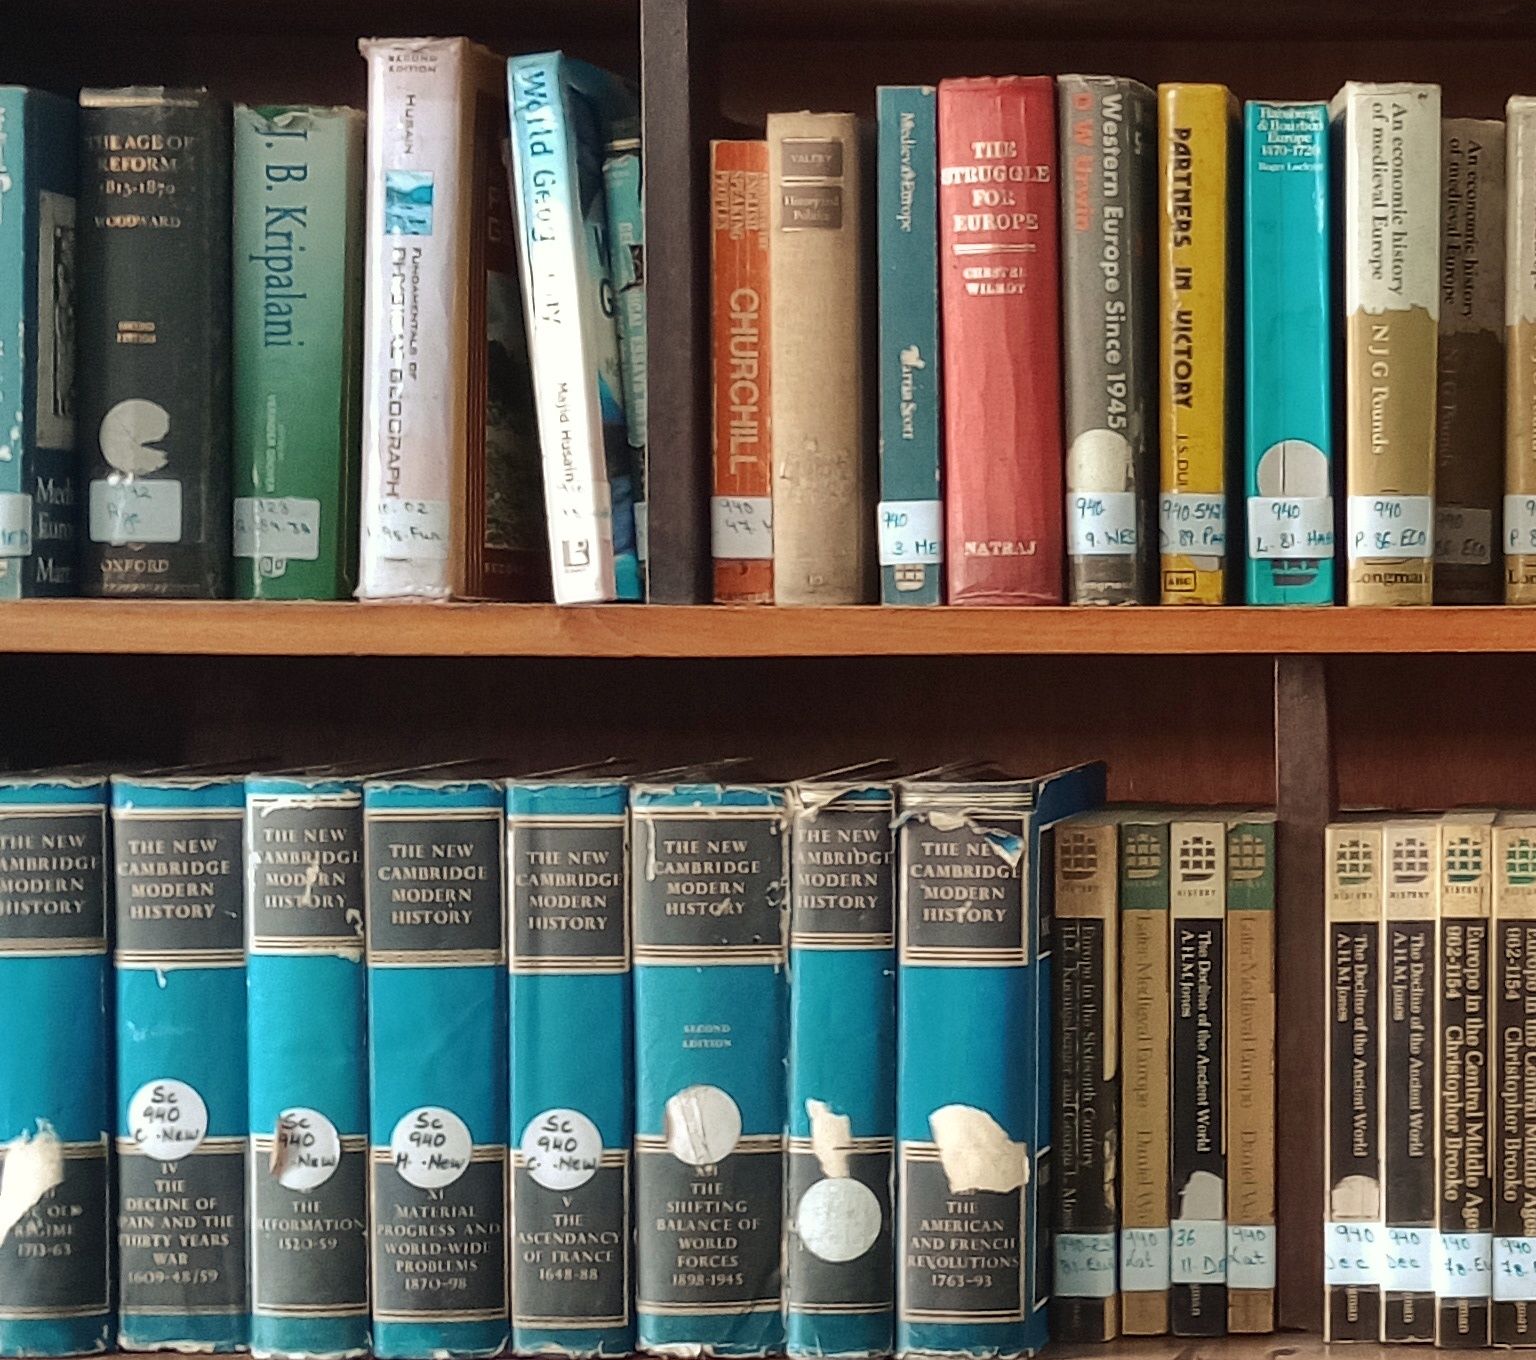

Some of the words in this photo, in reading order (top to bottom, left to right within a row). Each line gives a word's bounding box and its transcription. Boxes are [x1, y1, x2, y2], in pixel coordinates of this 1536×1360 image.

[1372, 102, 1389, 123] of
[1392, 102, 1408, 131] An
[970, 141, 1018, 161] THE
[1101, 93, 1124, 198] Western
[941, 165, 1050, 185] STRUGGLE
[1372, 125, 1390, 211] medieval
[1173, 127, 1193, 250] PARTNERS
[1391, 133, 1408, 229] economic
[971, 189, 1016, 207] FOR
[952, 212, 1039, 232] EUROPE
[1101, 201, 1122, 294] Europe
[1368, 215, 1389, 281] Europe
[1388, 230, 1408, 296] history
[249, 204, 309, 349] Kripalani
[1174, 265, 1193, 293] IN
[1103, 297, 1126, 367] Since
[1174, 310, 1195, 410] VICTORY
[727, 287, 761, 477] CHURCHILL
[1107, 369, 1128, 431] 1945
[128, 839, 168, 856] THE
[174, 838, 219, 855] NEW
[388, 844, 426, 860] THE
[432, 843, 474, 860] NEW
[664, 840, 701, 854] THE
[706, 840, 749, 854] NEW
[526, 851, 566, 866] THE
[570, 851, 610, 866] NEW
[118, 859, 231, 877] CAMBRIDGE
[378, 866, 487, 882] CAMBRIDGE
[653, 860, 761, 876] CAMBRIDGE
[130, 882, 215, 898] MODERN
[391, 888, 472, 903] MODERN
[666, 880, 746, 896] MODERN
[529, 894, 607, 909] MODERN
[665, 900, 746, 917] HISTORY
[129, 902, 216, 920] HISTORY
[390, 909, 472, 926] HISTORY
[395, 1204, 476, 1218] MATERIAL
[945, 1200, 979, 1215] THE
[919, 1219, 1006, 1233] AMERICAN
[678, 1236, 738, 1251] WORLD
[910, 1237, 944, 1252] AND
[676, 1254, 739, 1269] FORCES
[931, 1273, 994, 1289] 1763-93
